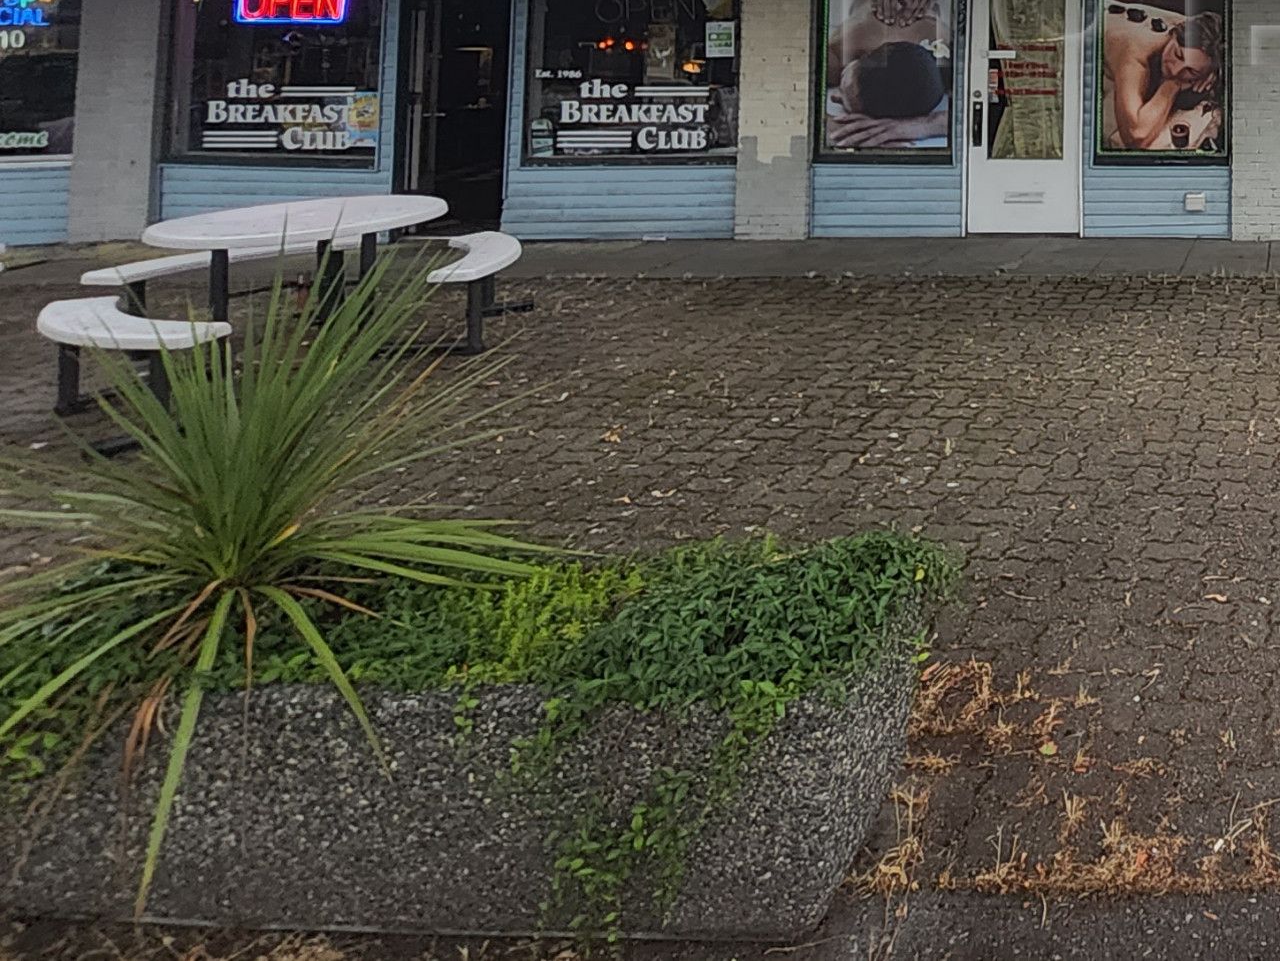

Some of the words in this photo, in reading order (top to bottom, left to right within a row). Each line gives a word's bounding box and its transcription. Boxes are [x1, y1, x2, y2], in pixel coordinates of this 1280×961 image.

[227, 78, 276, 99] the
[579, 78, 628, 99] the
[205, 100, 354, 124] BREAKFAST
[559, 100, 710, 124] BREAKFAST
[281, 126, 352, 150] CLUB
[636, 126, 708, 150] CLUB
